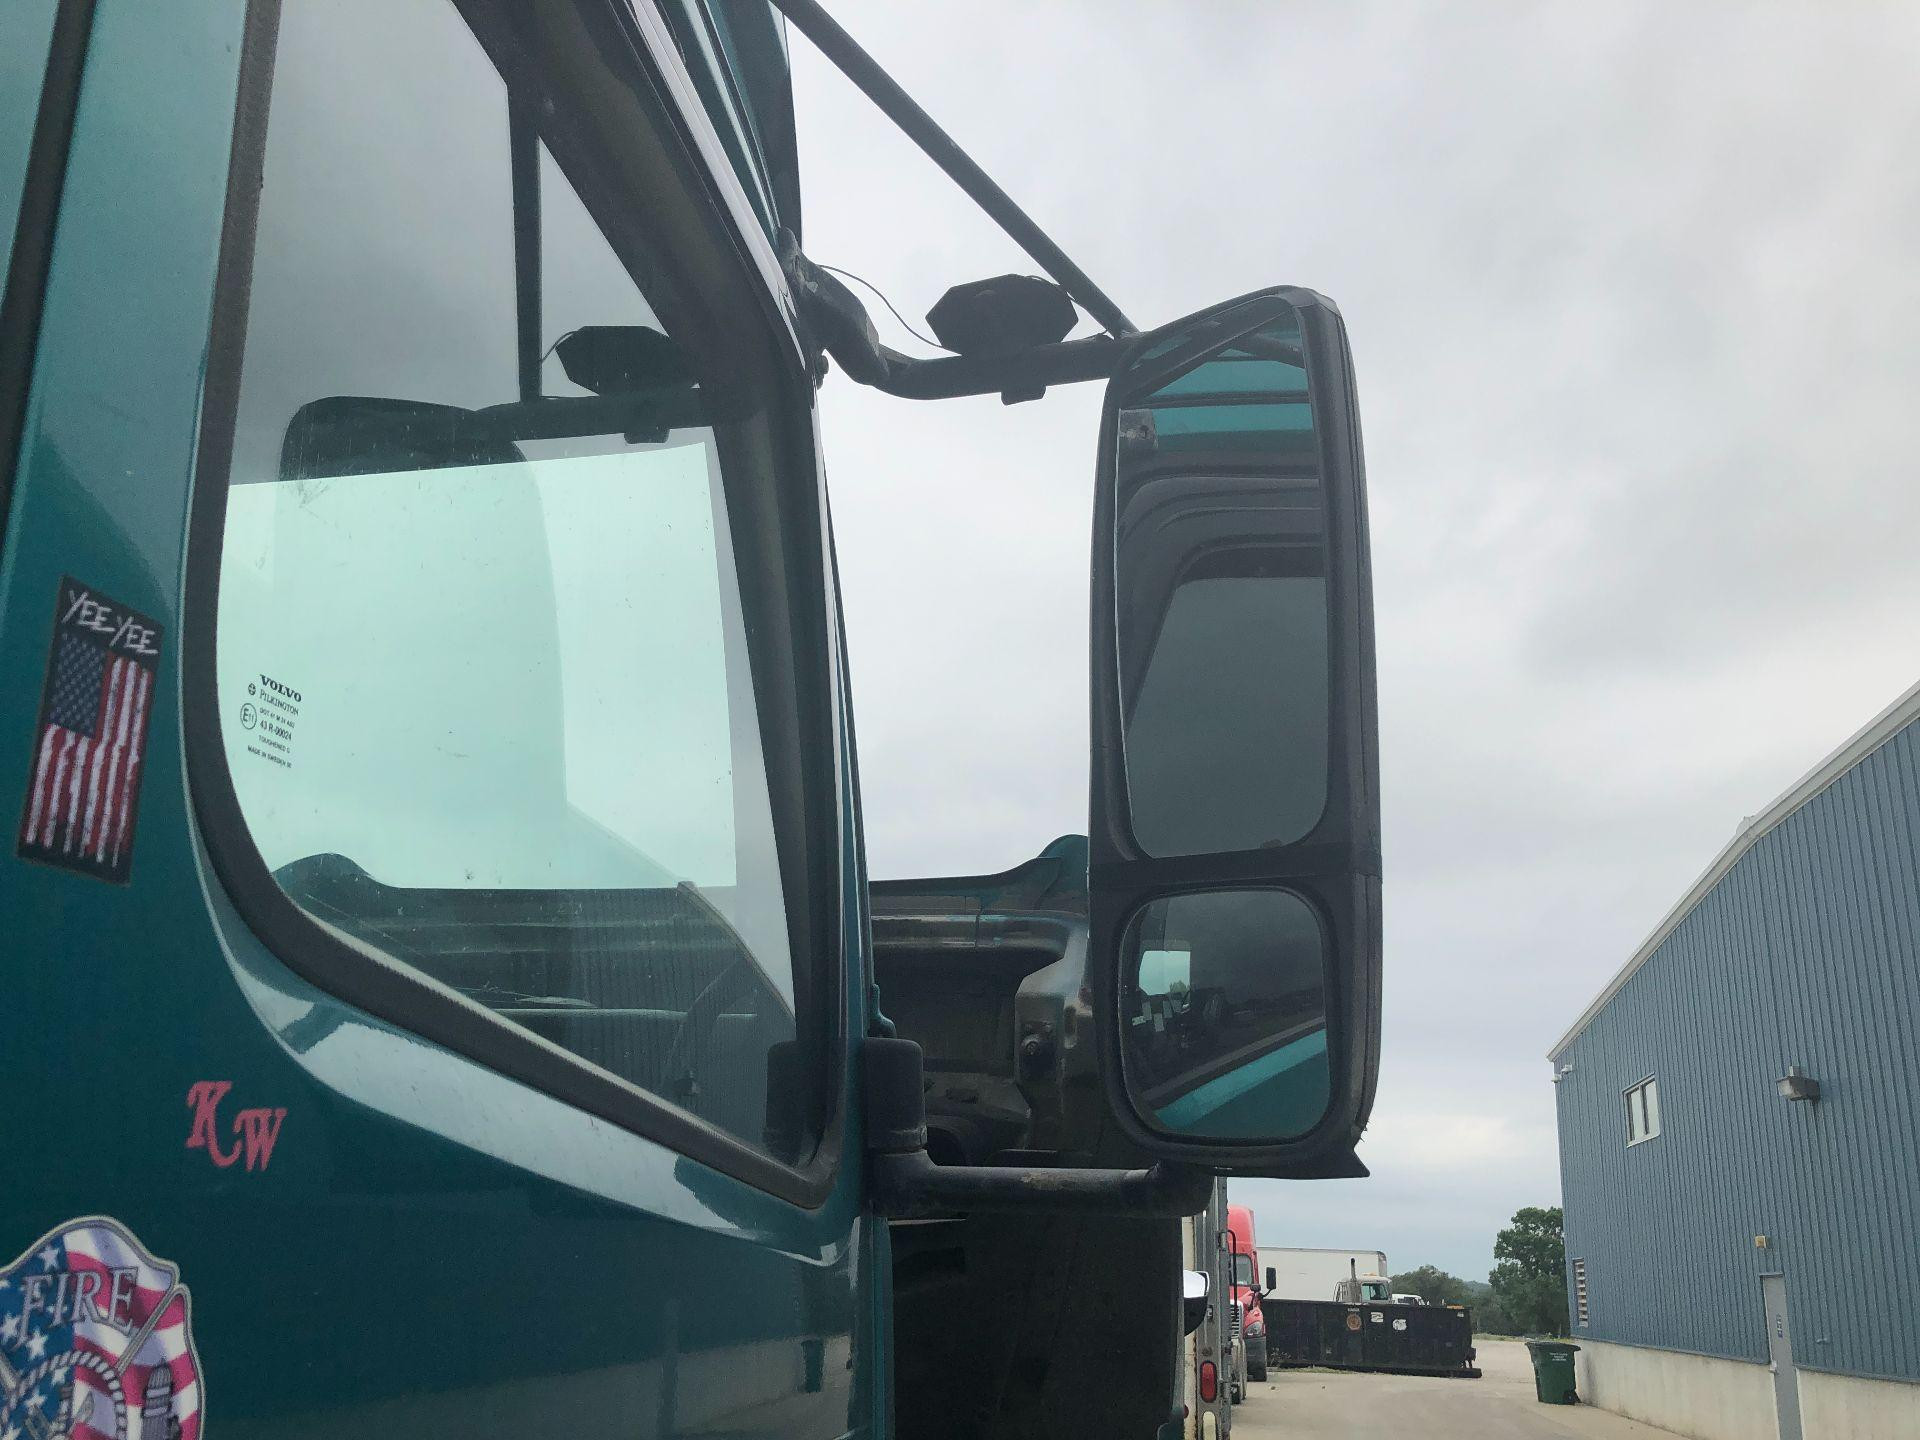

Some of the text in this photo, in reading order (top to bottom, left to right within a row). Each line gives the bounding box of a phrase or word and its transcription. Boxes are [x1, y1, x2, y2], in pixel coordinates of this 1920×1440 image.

[61, 590, 159, 655] YEE YEE
[260, 674, 302, 702] VOLVO
[260, 689, 299, 716] PILKINGTON
[248, 744, 261, 756] MADE
[267, 753, 286, 767] SWEDEN
[13, 1265, 139, 1352] FIRE
